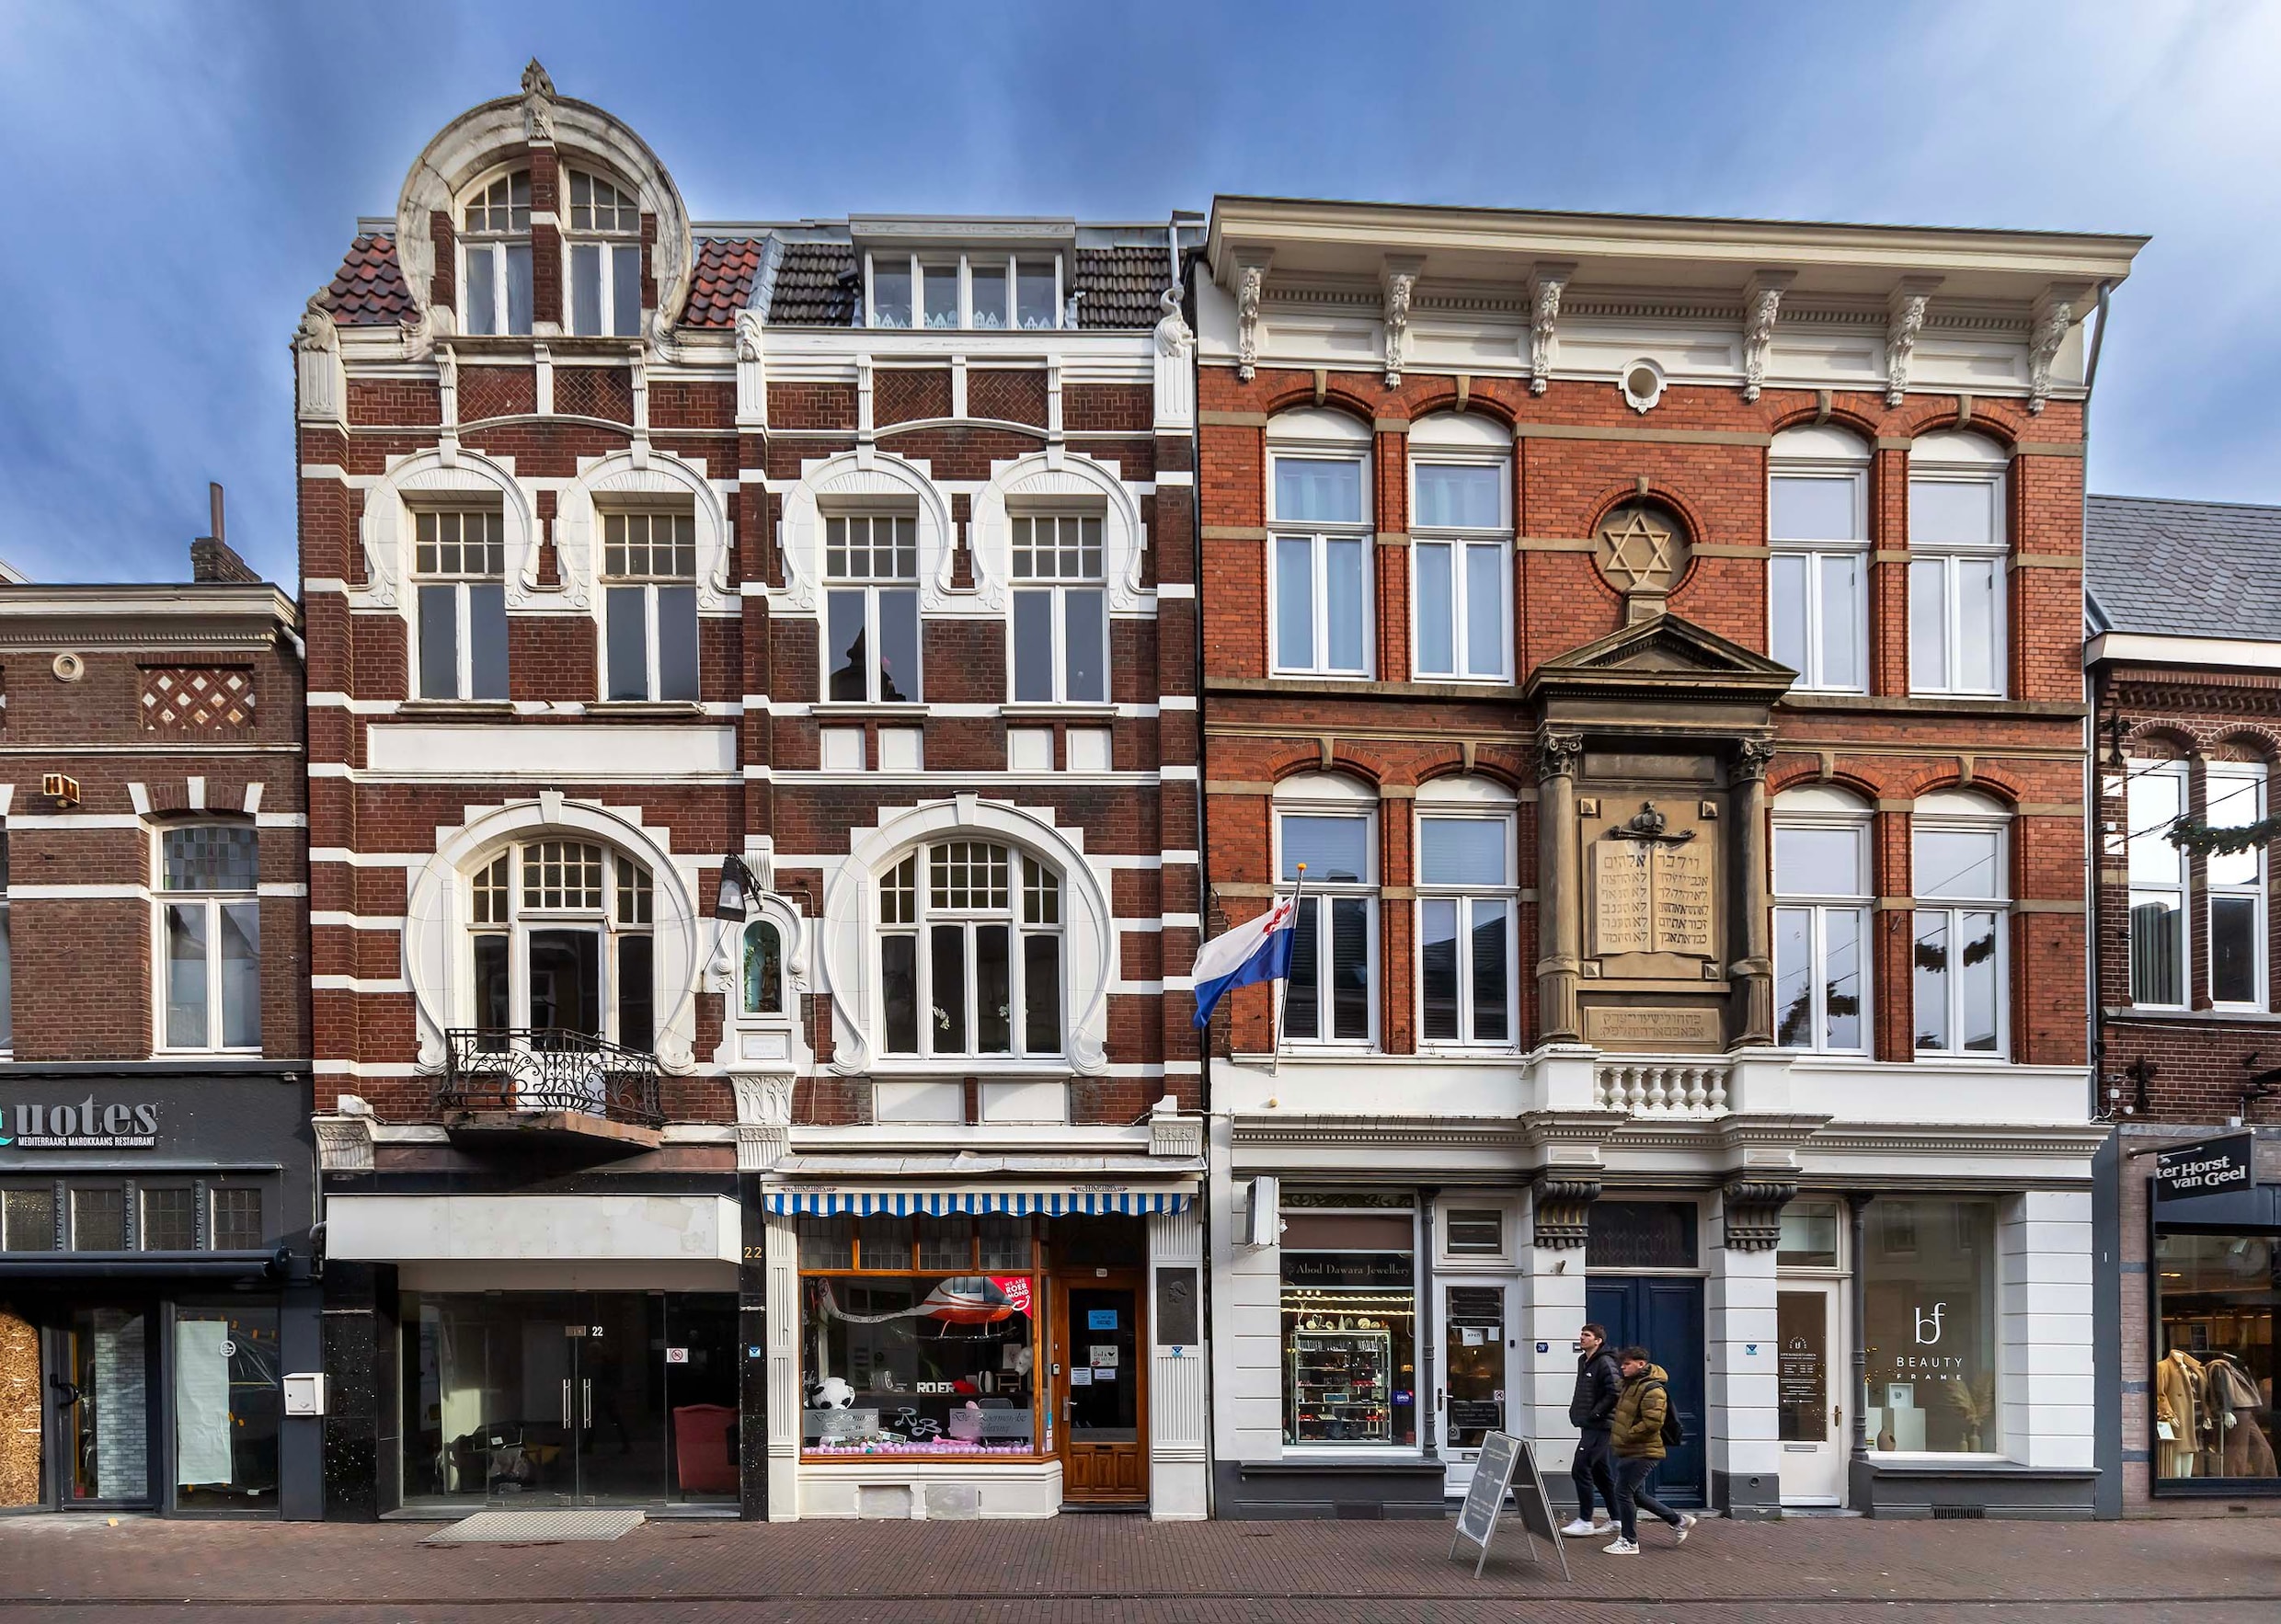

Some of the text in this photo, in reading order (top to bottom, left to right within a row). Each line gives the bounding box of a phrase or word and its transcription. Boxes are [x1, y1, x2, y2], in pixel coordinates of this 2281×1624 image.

[17, 1136, 155, 1147] MEDITERRAANS MAROKKAANS RESTAURANT
[2155, 1156, 2230, 1179] ter Horst
[2172, 1165, 2246, 1189] van Geel
[744, 1246, 762, 1259] 22
[1326, 1264, 1363, 1275] Dawara
[1366, 1263, 1409, 1277] Jewellery
[1005, 1282, 1027, 1294] ROER
[1007, 1288, 1029, 1298] MOND
[591, 1325, 603, 1337] 22
[1897, 1356, 1962, 1367] BEAUTY
[916, 1381, 956, 1393] ROER
